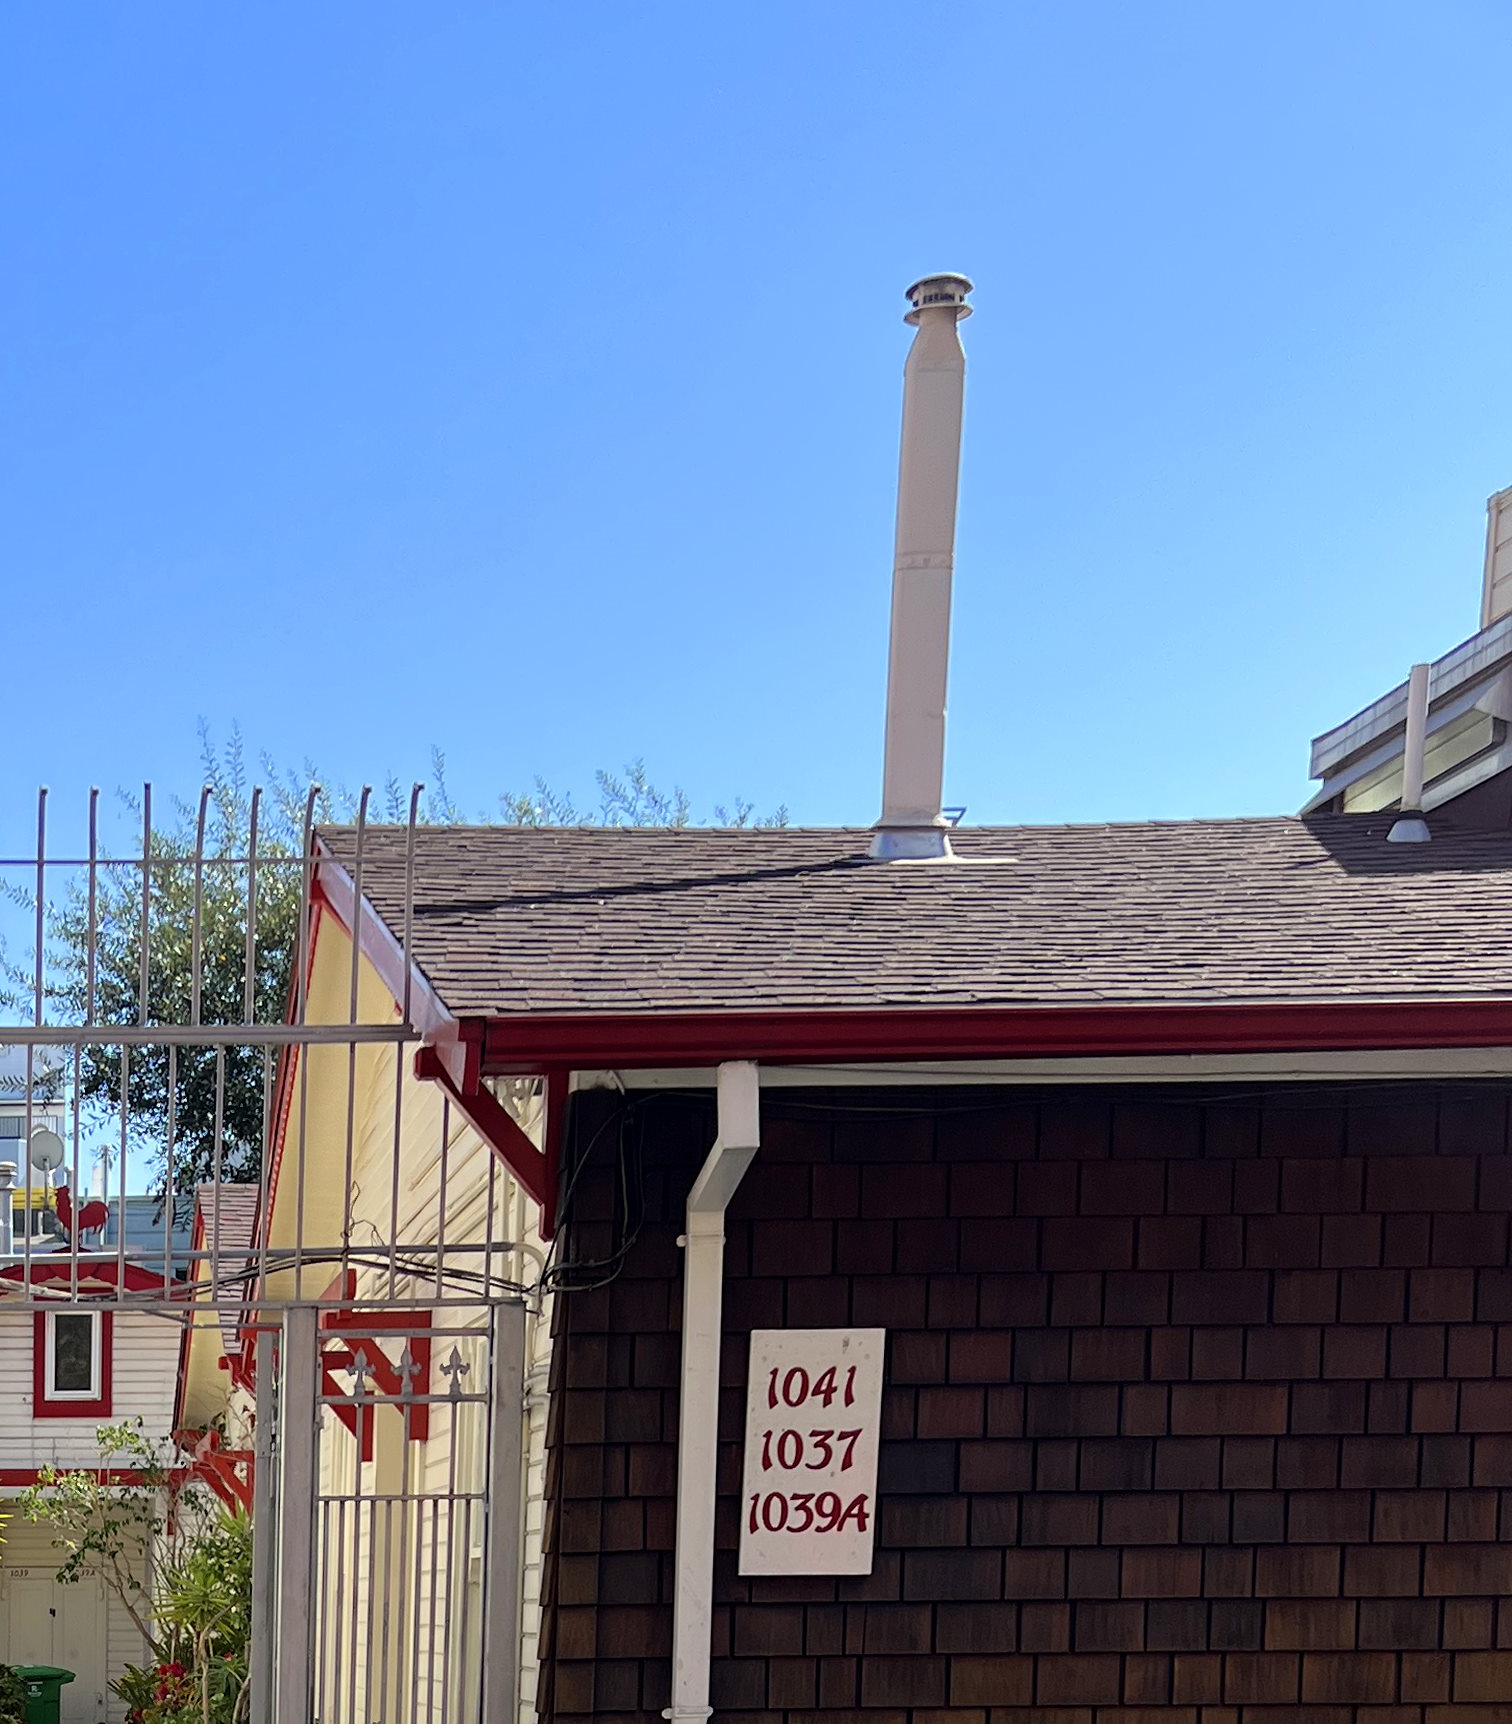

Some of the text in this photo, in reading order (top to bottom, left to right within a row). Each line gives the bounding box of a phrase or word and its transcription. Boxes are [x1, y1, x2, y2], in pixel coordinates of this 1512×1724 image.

[768, 1366, 857, 1409] 1041
[762, 1428, 863, 1472] 1037
[749, 1491, 870, 1534] 1039A
